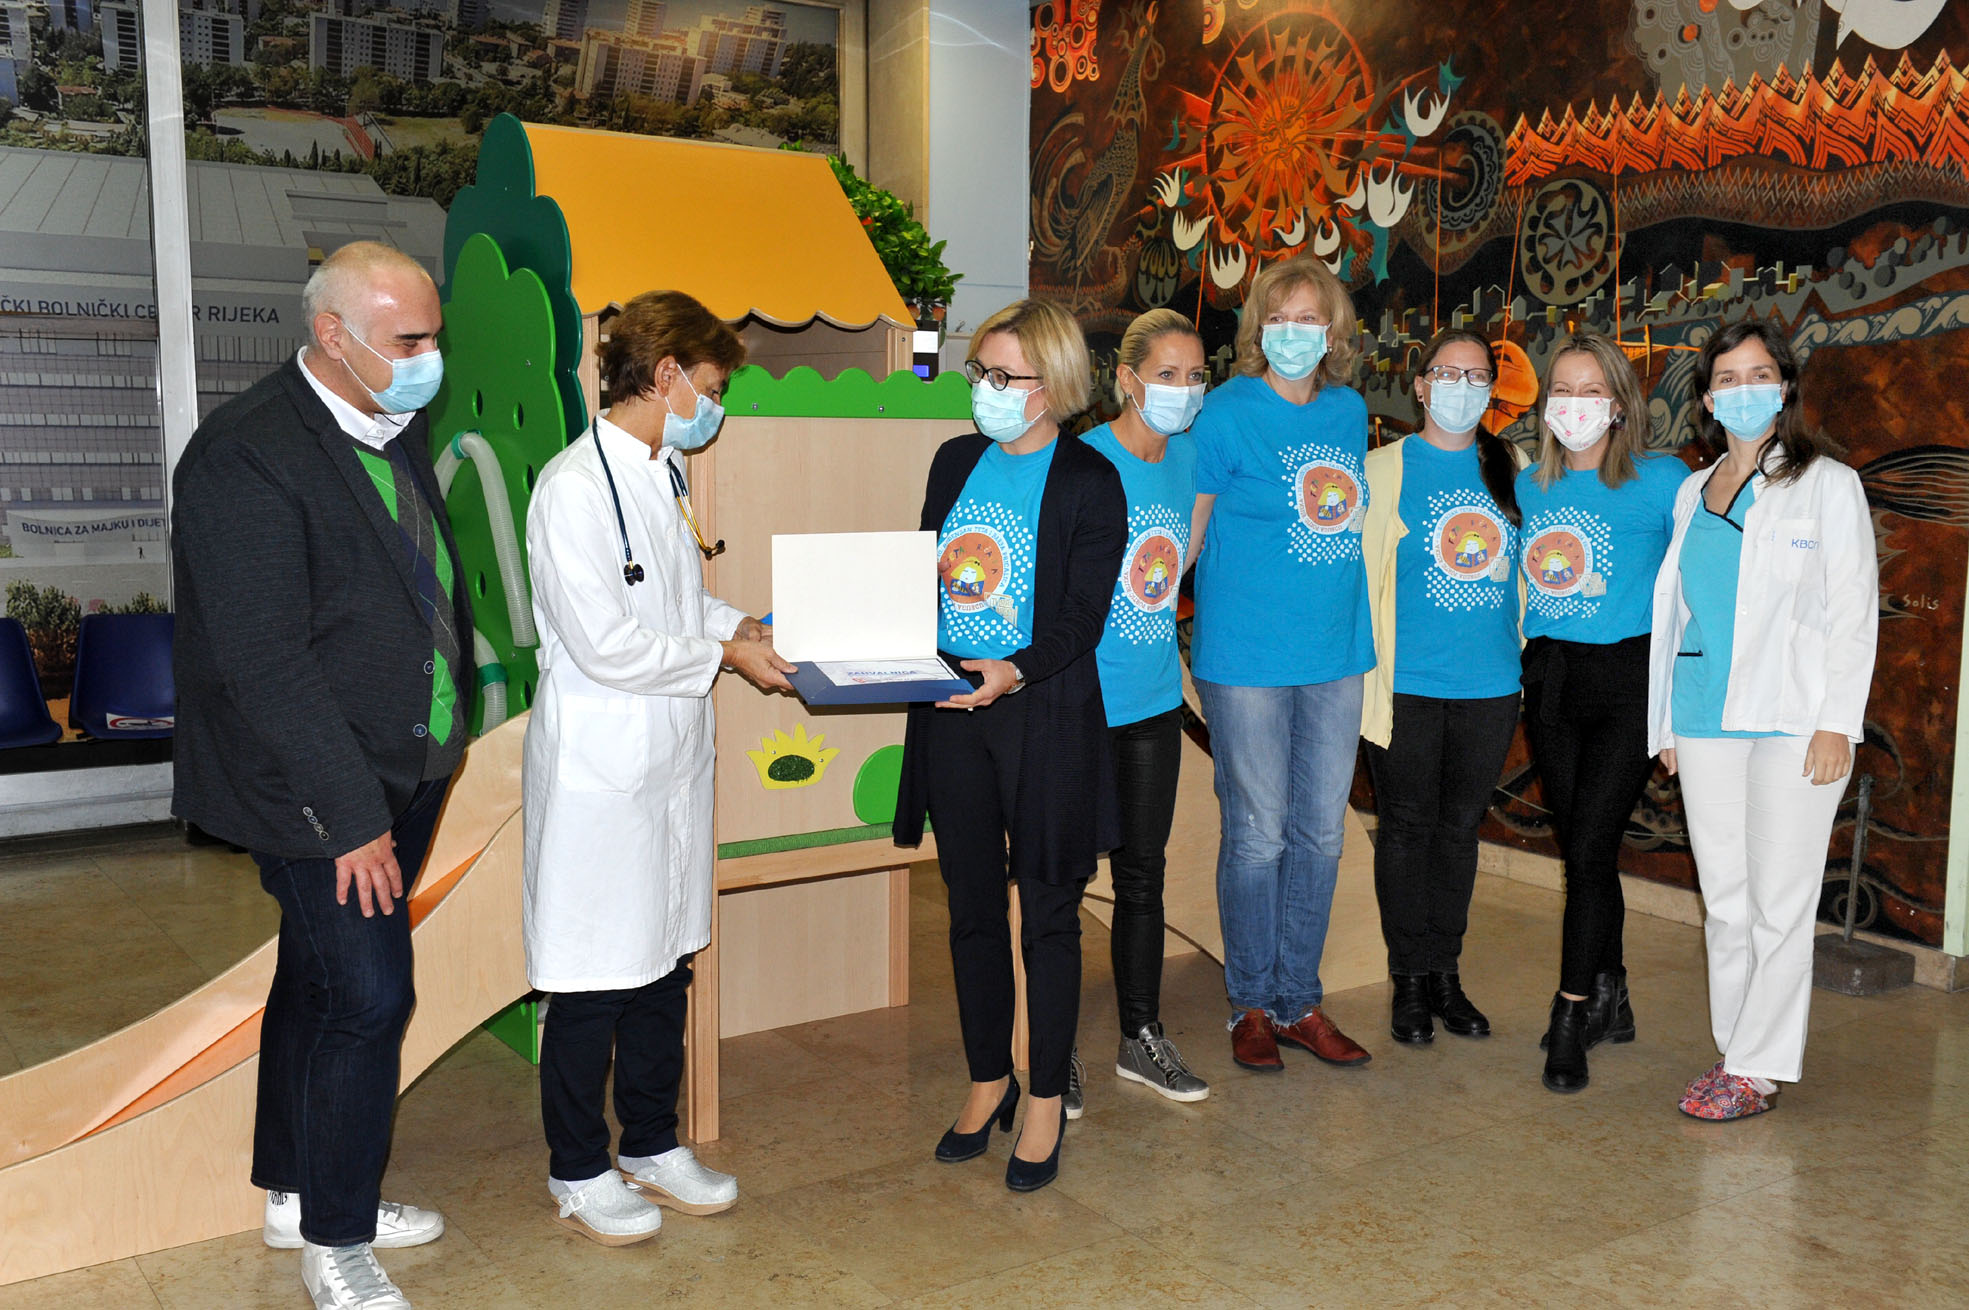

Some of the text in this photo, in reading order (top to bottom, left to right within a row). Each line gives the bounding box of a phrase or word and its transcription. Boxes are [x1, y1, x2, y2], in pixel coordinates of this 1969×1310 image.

[38, 299, 130, 318] BOLNIČKI
[208, 305, 280, 323] RIJEKA
[22, 522, 72, 536] BOLNICA
[75, 525, 90, 535] ZA
[92, 519, 129, 534] MAJKU
[1903, 594, 1940, 610] Solis
